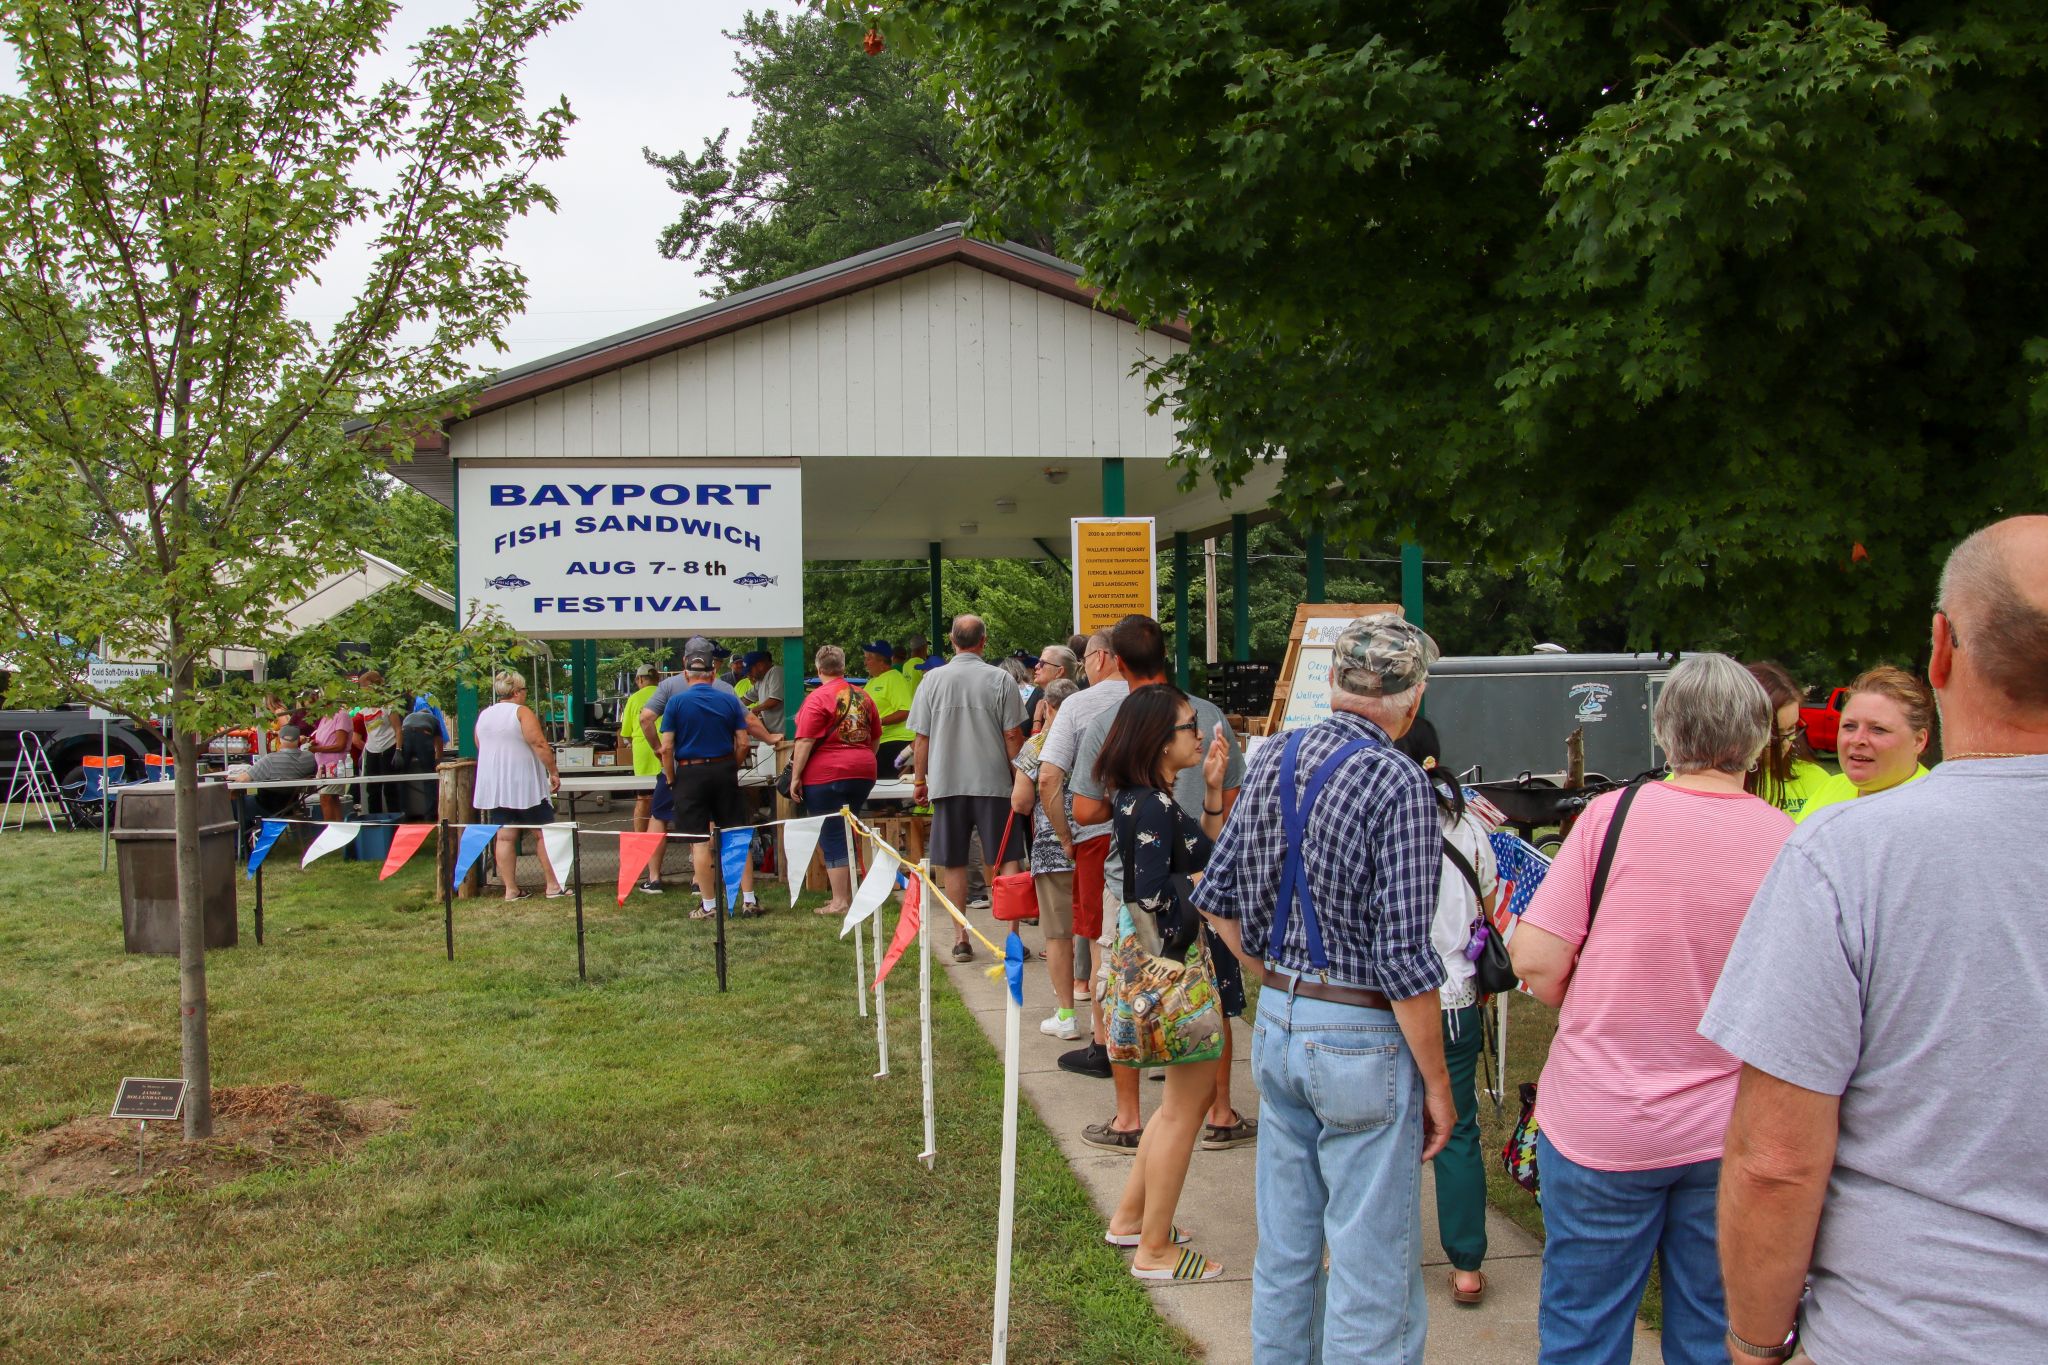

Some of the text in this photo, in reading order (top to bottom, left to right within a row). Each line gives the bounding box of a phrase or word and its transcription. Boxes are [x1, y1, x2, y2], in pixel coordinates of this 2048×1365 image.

[490, 484, 772, 507] BAYPORT
[494, 515, 761, 555] FISH SANDWICH
[566, 560, 636, 575] AUG
[533, 595, 721, 614] FESTIVAL
[91, 667, 104, 676] Cold
[105, 667, 134, 677] Soft-Drinks
